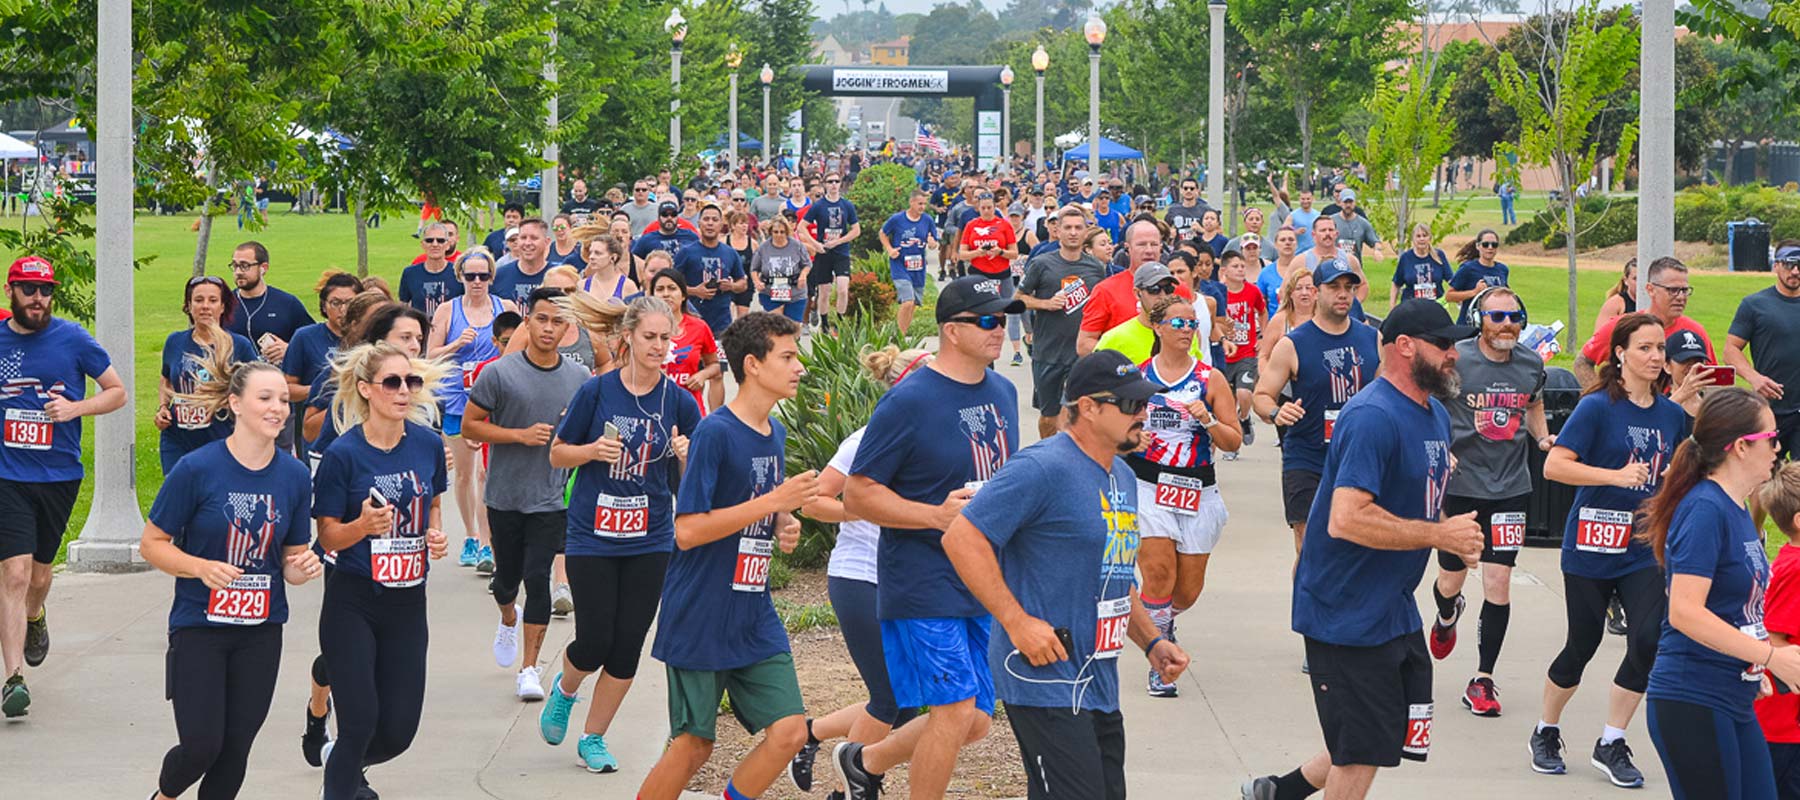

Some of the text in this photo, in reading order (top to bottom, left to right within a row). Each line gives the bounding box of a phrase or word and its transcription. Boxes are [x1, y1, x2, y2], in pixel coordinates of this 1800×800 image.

[882, 78, 930, 88] FROGMEN
[1466, 393, 1496, 408] SAN
[10, 422, 48, 443] 1391
[1159, 485, 1197, 510] 2212
[600, 508, 644, 531] 2123
[1497, 524, 1527, 545] 159
[1585, 522, 1627, 547] 1397
[377, 554, 421, 580] 2076
[214, 590, 265, 617] 2329
